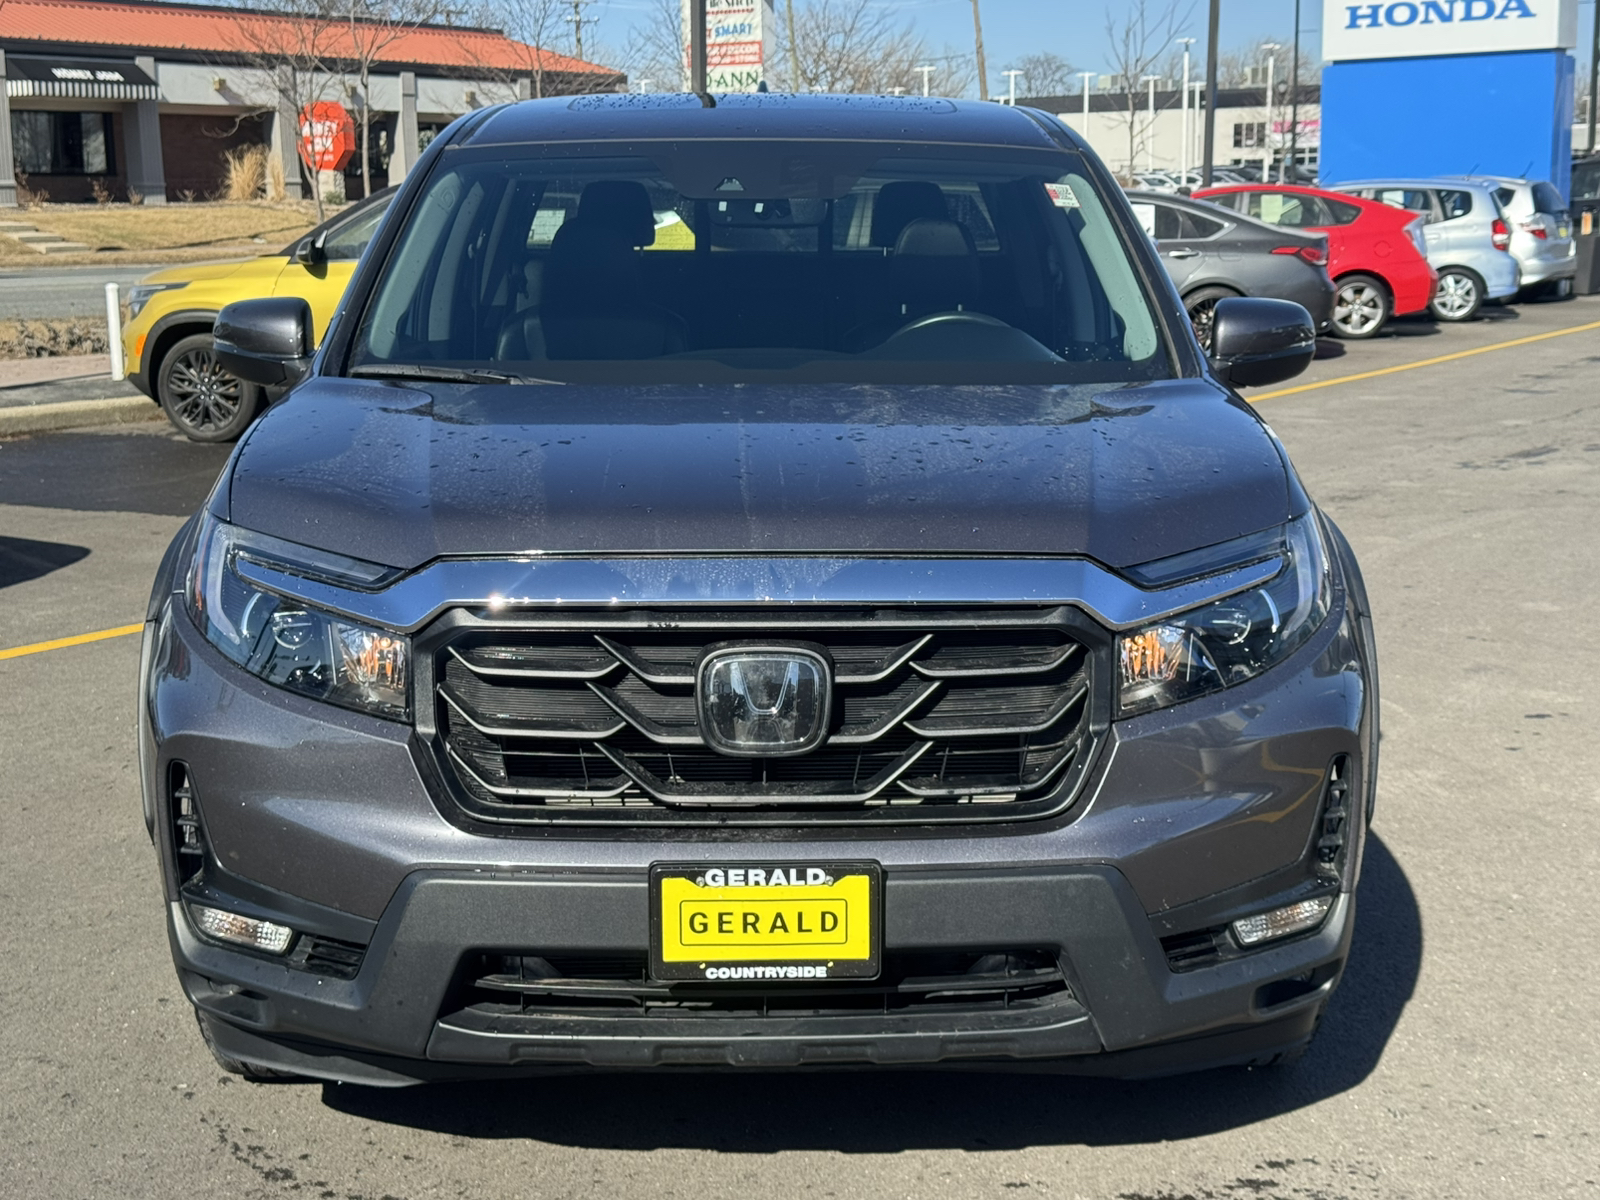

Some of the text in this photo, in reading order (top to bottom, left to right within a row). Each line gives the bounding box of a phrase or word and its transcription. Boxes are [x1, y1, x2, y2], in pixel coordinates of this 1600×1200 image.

[1345, 0, 1536, 29] HONDA
[715, 24, 752, 37] SMART
[704, 868, 826, 887] GERALD
[688, 911, 839, 934] GERALD
[705, 966, 827, 979] COUNTRYSIDE
